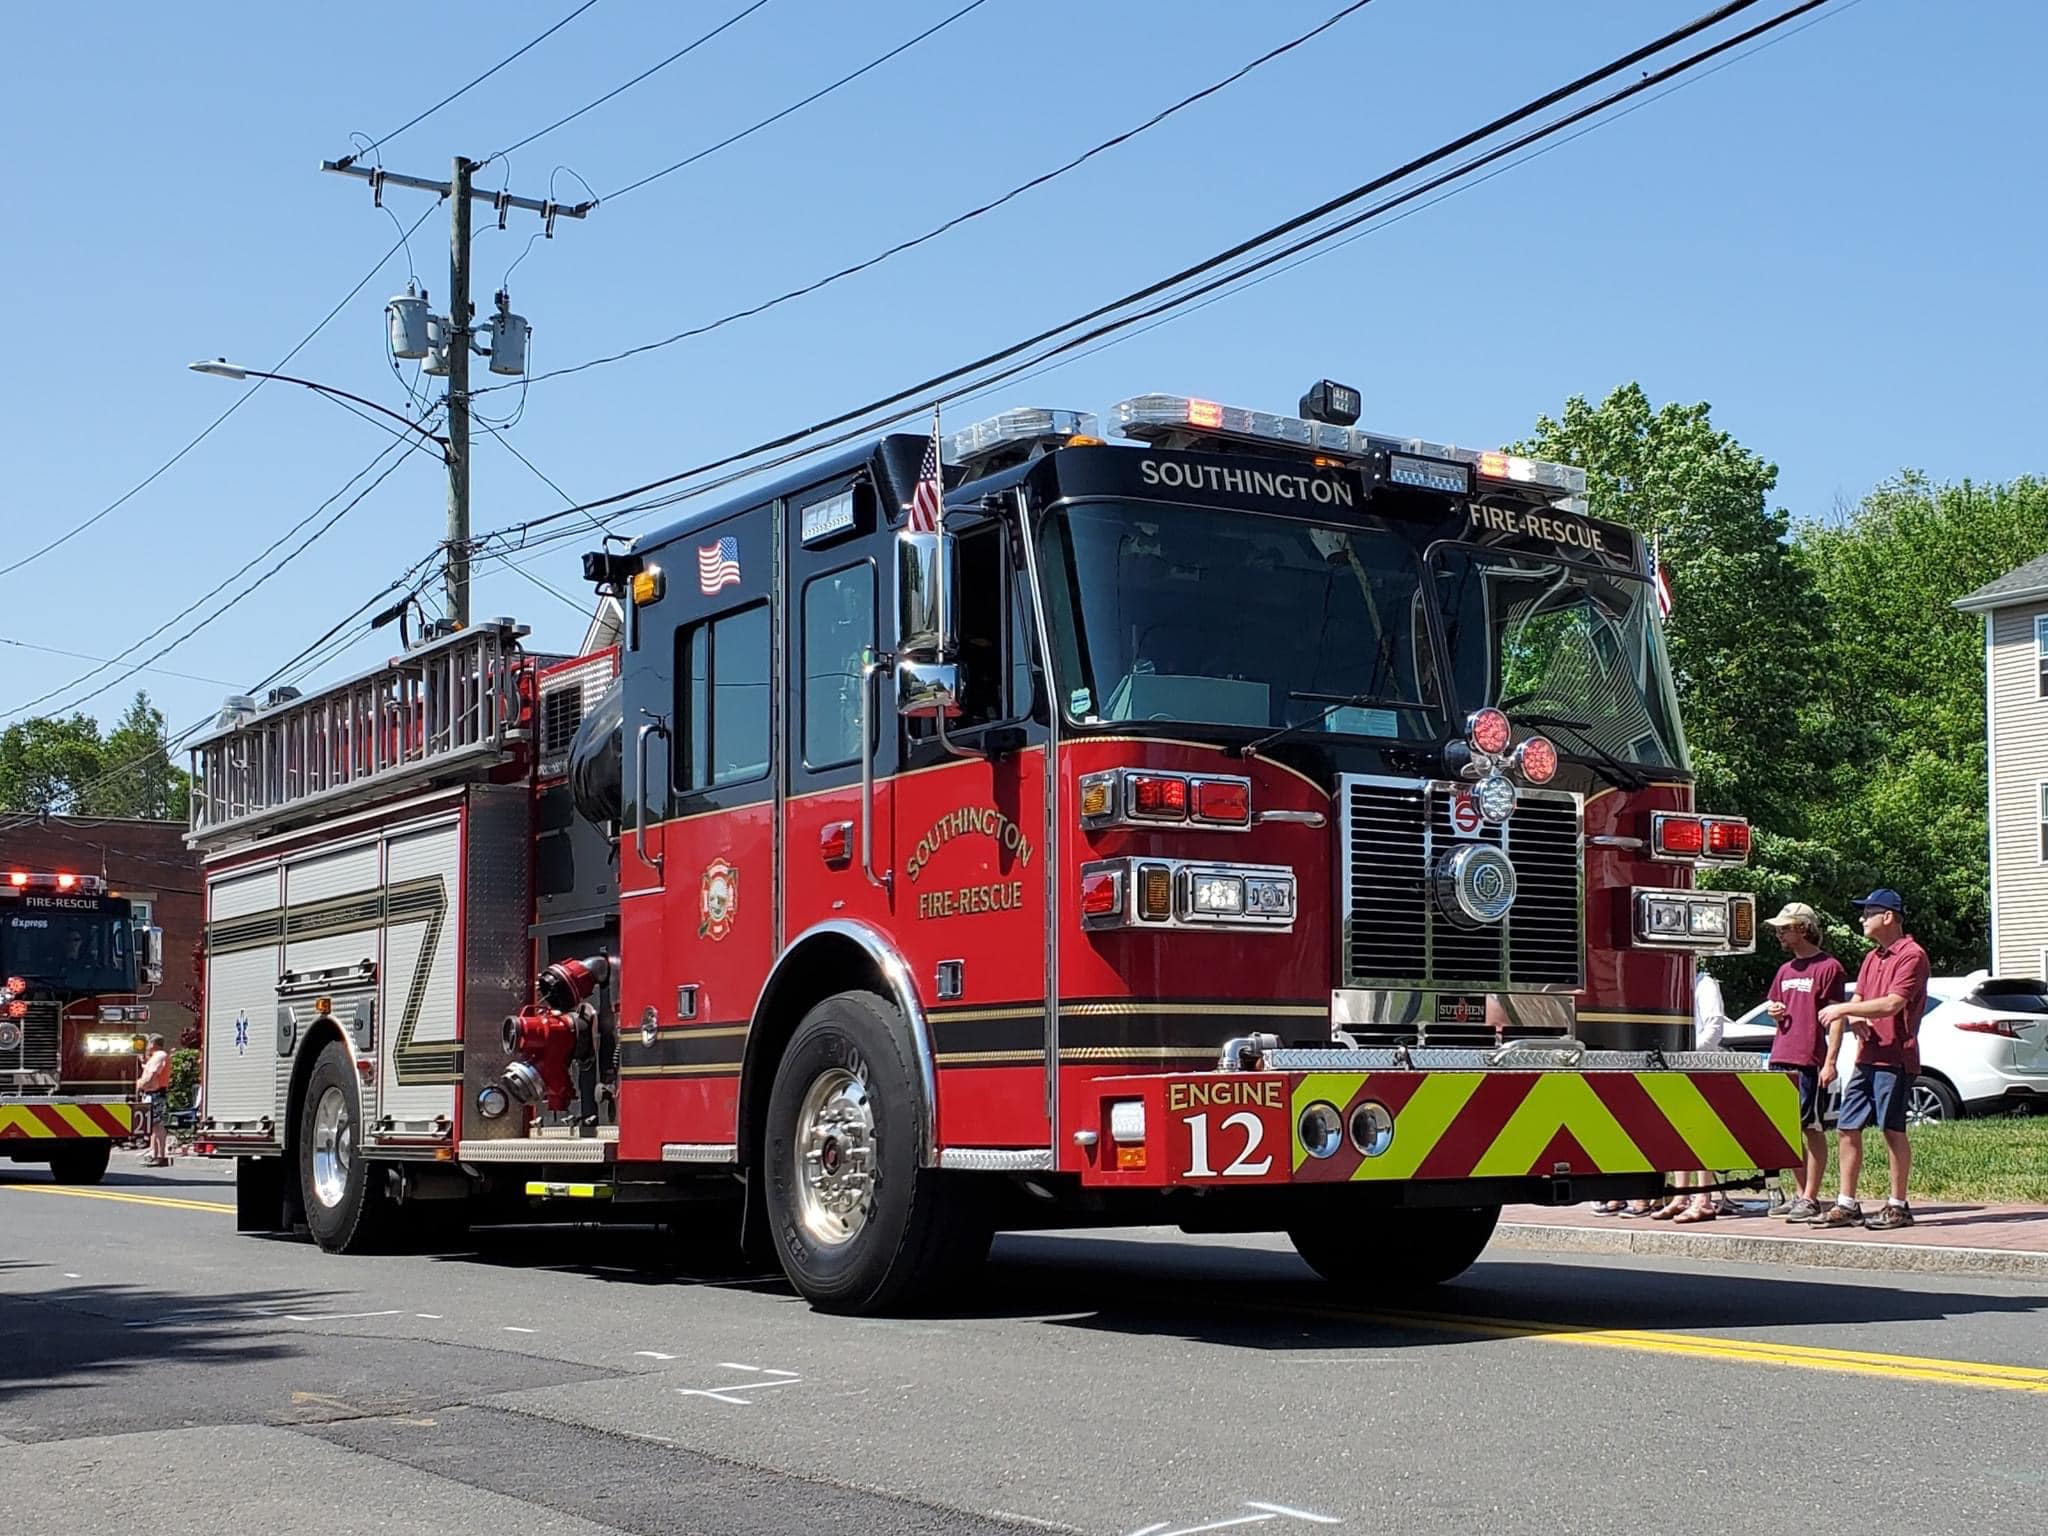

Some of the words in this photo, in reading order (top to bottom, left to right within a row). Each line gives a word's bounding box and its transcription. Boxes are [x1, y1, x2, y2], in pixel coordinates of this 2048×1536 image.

[1140, 459, 1353, 507] SOUTHINGTON
[1469, 503, 1605, 551] FIRE-RESCUE
[906, 806, 1034, 882] SOUTHINGTON
[26, 897, 100, 910] FIRE-RESCUE
[919, 881, 1023, 920] FIRE-RESCUE
[1169, 1081, 1284, 1112] ENGINE
[133, 1110, 152, 1135] 21
[1182, 1111, 1273, 1177] 12
